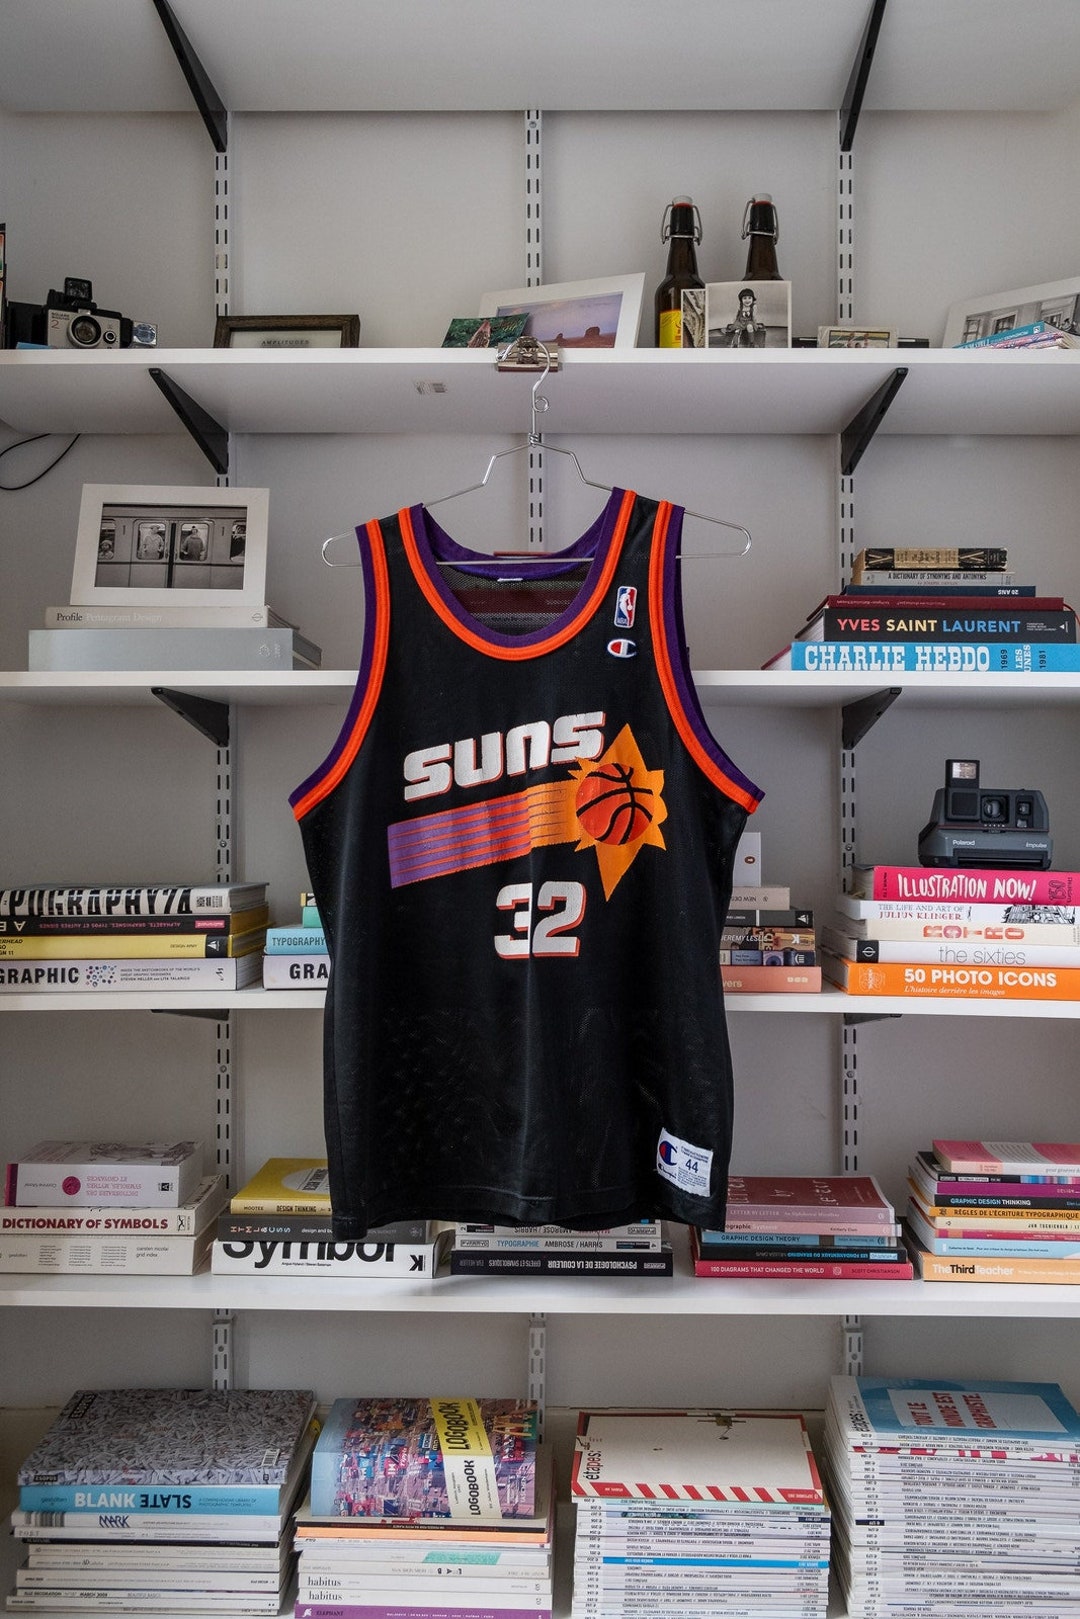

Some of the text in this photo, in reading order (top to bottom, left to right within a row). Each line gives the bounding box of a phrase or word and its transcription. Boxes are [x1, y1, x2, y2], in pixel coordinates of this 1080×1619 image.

[51, 320, 60, 330] 2
[56, 612, 83, 622] Profile
[837, 618, 881, 631] YVES
[886, 619, 938, 633] SAINT
[942, 620, 1021, 633] LAURENT
[804, 645, 990, 672] CHARLIE HEBDO
[1000, 649, 1008, 670] 1969
[1014, 649, 1023, 670] LES
[1023, 644, 1032, 672] UNES
[1038, 649, 1047, 670] 1981
[404, 711, 605, 802] SUNS
[952, 838, 1048, 849] Polaroid Impulse
[897, 873, 987, 899] ILLUSTRATION
[993, 877, 1037, 901] NOW!
[917, 904, 934, 912] AND
[953, 905, 964, 913] OF
[494, 880, 587, 959] 32
[879, 911, 962, 920] JULIUS KLINGER
[272, 937, 326, 947] TYPOGRAPHY
[938, 946, 1026, 965] the sixties
[289, 964, 329, 980] GRA
[904, 968, 1057, 987] 50 PHOTO ICONS
[904, 985, 938, 994] L'histoire
[980, 988, 1005, 996] images
[685, 1159, 699, 1174] 44
[989, 1209, 1024, 1217] L'ÉCRITURE
[1026, 1211, 1080, 1219] TYPOGRAPHIQUE
[2, 1218, 169, 1229] DICTIONARY OF SYMBOLS
[497, 1240, 539, 1248] TYPOGRAPHIE
[548, 1260, 576, 1269] COULEUR
[576, 1260, 585, 1269] LA
[586, 1260, 593, 1269] DE
[593, 1260, 637, 1270] PSYCHOLOGIE
[932, 1391, 955, 1404] EST
[907, 1401, 934, 1426] TOUT LE
[438, 1401, 471, 1450] LOGOBOOK
[464, 1460, 482, 1516] LOGOBOOK
[74, 1492, 136, 1508] BLANK
[140, 1493, 192, 1509] SLATE
[99, 1515, 131, 1528] MARK
[307, 1576, 342, 1587] habitus
[308, 1590, 343, 1601] habitus
